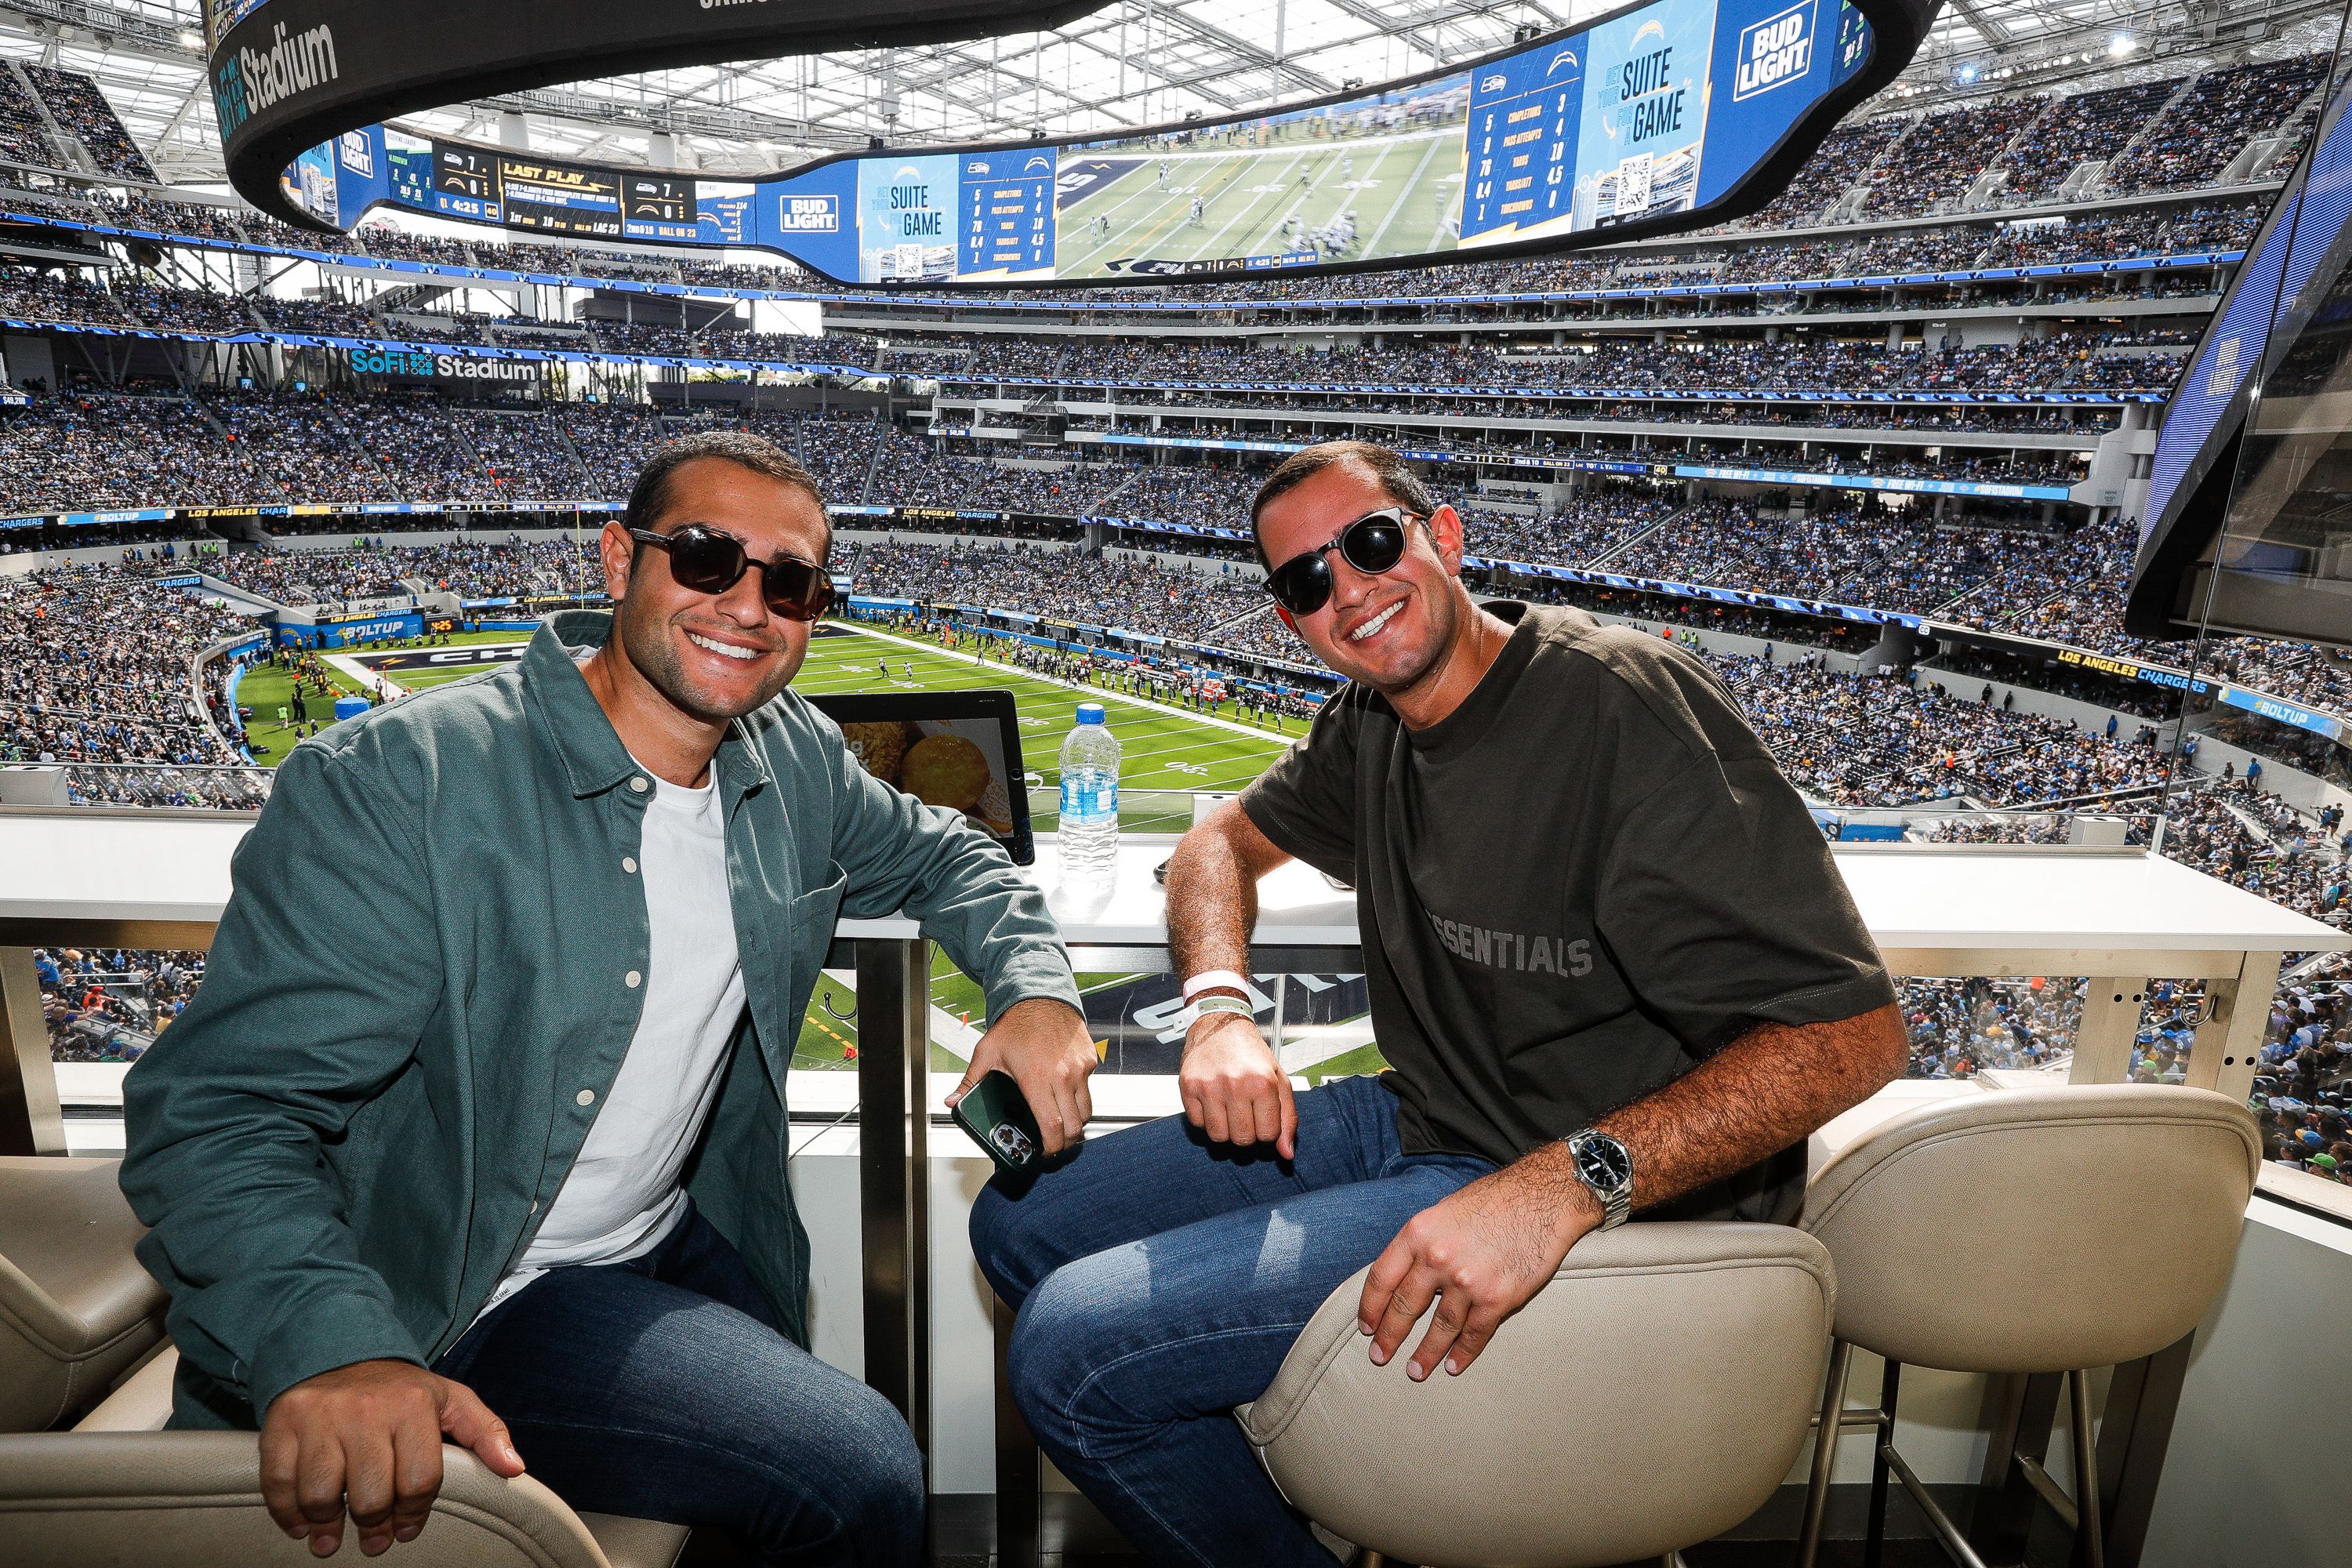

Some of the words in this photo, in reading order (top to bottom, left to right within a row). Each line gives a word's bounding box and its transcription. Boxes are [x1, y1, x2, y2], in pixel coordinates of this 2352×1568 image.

[1751, 13, 1803, 60] BUD
[241, 21, 339, 114] Stadium
[1621, 46, 1673, 101] SUITE
[1486, 114, 1494, 132] 5
[1508, 105, 1542, 124] COMPLETIONS
[1558, 93, 1566, 113] 3
[1633, 89, 1686, 142] GAME
[343, 132, 364, 152] BUD
[1483, 136, 1491, 154] 9
[1503, 133, 1516, 147] PASS
[1516, 128, 1543, 144] ATTEMPTS
[1555, 118, 1564, 136] 4
[468, 155, 475, 171] 7
[1512, 154, 1529, 168] YARDS
[503, 162, 543, 179] LAST
[545, 169, 585, 185] PLAY
[1547, 165, 1564, 185] 4.5
[470, 180, 477, 194] 0
[663, 183, 671, 197] 7
[974, 189, 981, 201] 5
[993, 190, 1022, 199] COMPLETIONS
[1035, 185, 1042, 198] 3
[891, 185, 928, 209] SUITE
[452, 199, 479, 214] 4:25
[487, 207, 497, 216] 40
[664, 205, 672, 219] 0
[790, 199, 828, 214] BUD
[974, 205, 981, 217] 9
[991, 206, 1002, 215] PASS
[1035, 201, 1042, 213] 4
[1478, 204, 1486, 221] 1
[510, 212, 522, 223] 1ST
[904, 212, 942, 236] GAME
[593, 222, 608, 234] LAC
[608, 223, 619, 234] 23
[659, 226, 675, 237] BALL
[676, 227, 685, 237] ON
[1031, 234, 1045, 245] 4.5
[973, 252, 979, 263] 1
[1255, 258, 1270, 267] 4:25
[351, 350, 405, 374] SoFi
[437, 354, 535, 381] Stadium
[3, 396, 26, 405] $49,200
[1718, 470, 1732, 478] FREE
[1887, 479, 1904, 489] FREE
[1905, 480, 1924, 491] WI-FI
[211, 508, 259, 517] ANGELES
[259, 506, 288, 515] CHAR
[344, 612, 376, 622] ANGELES
[376, 609, 412, 618] CHARGERS
[431, 619, 452, 631] 4:25
[2058, 650, 2081, 663] LOS
[2082, 655, 2138, 677] ANGELES
[2138, 669, 2207, 695] CHARGERS
[1425, 909, 1593, 978] SSENTIALS
